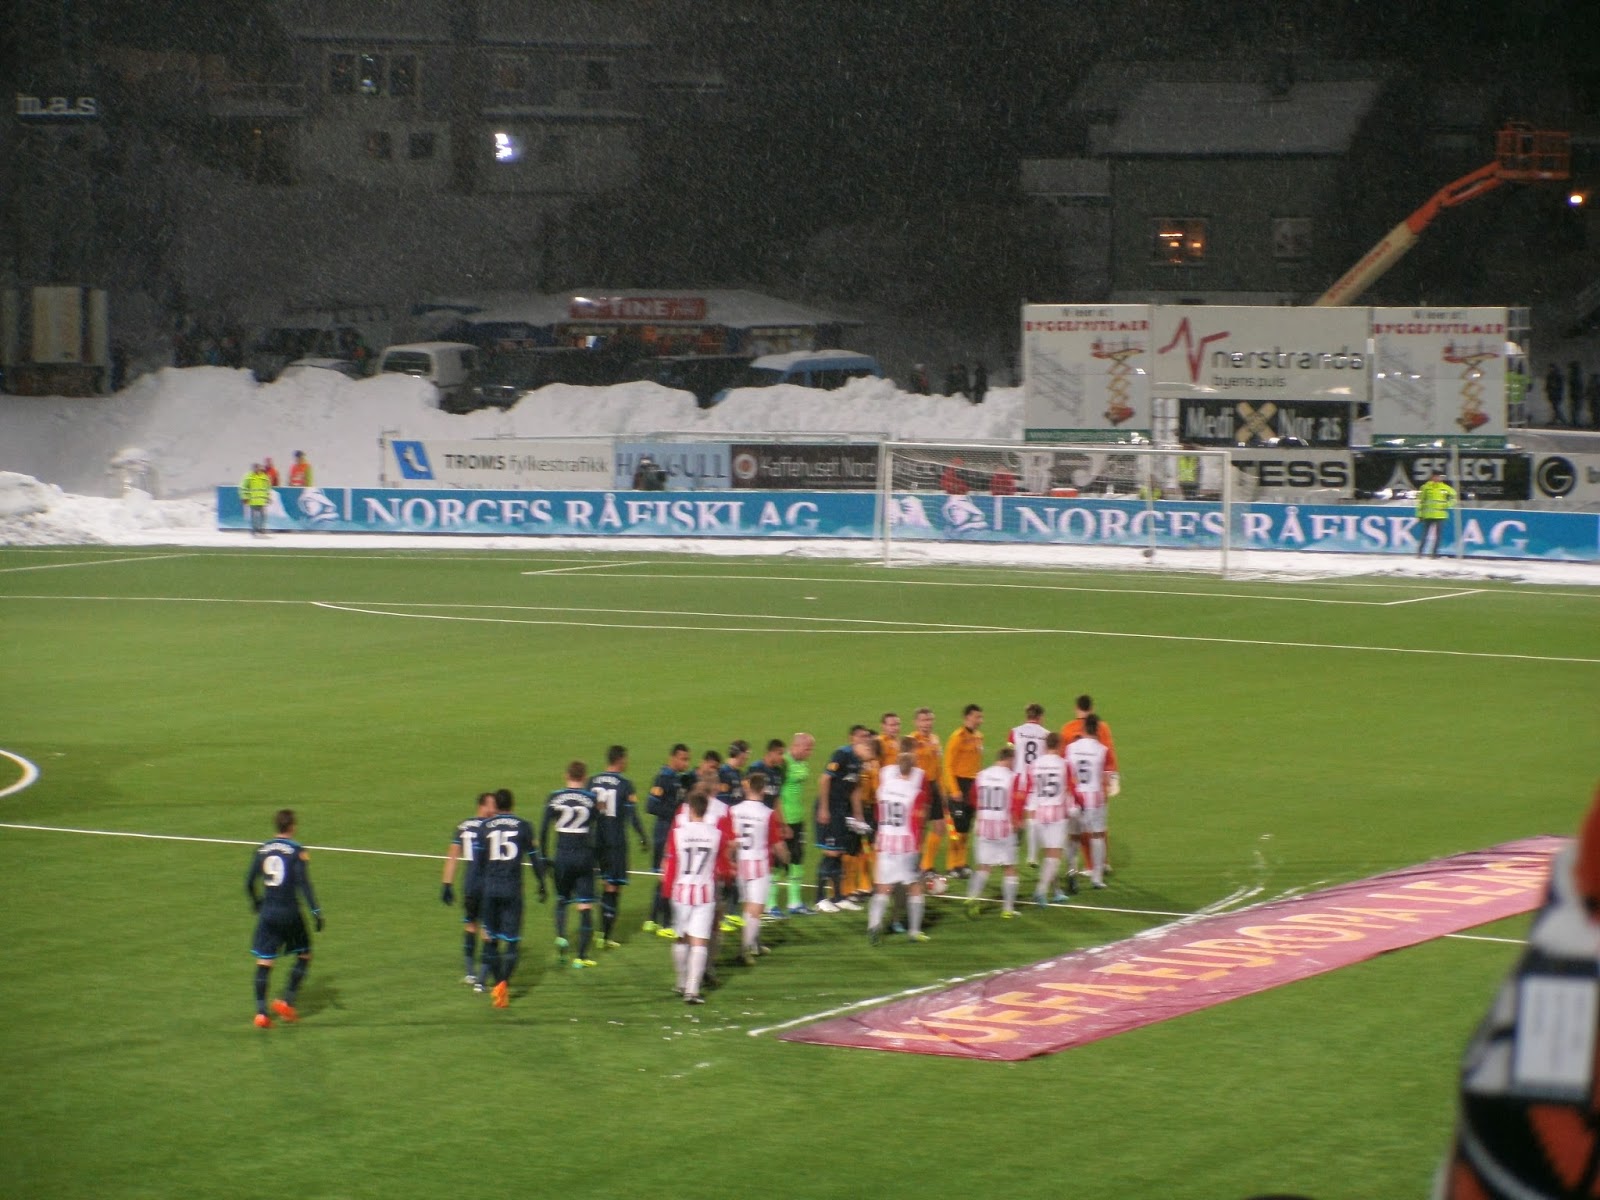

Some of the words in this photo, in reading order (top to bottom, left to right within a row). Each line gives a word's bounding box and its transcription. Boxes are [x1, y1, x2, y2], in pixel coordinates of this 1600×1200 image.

[443, 453, 507, 471] TROMS
[509, 455, 609, 475] fylkestrafikk
[1231, 460, 1348, 487] TESS
[363, 496, 553, 529] NORGES
[1016, 506, 1226, 540] NORGES
[1024, 740, 1039, 765] 8
[551, 804, 591, 834] 22
[485, 829, 519, 861] 15
[262, 854, 286, 887] 9
[683, 846, 714, 875] 17
